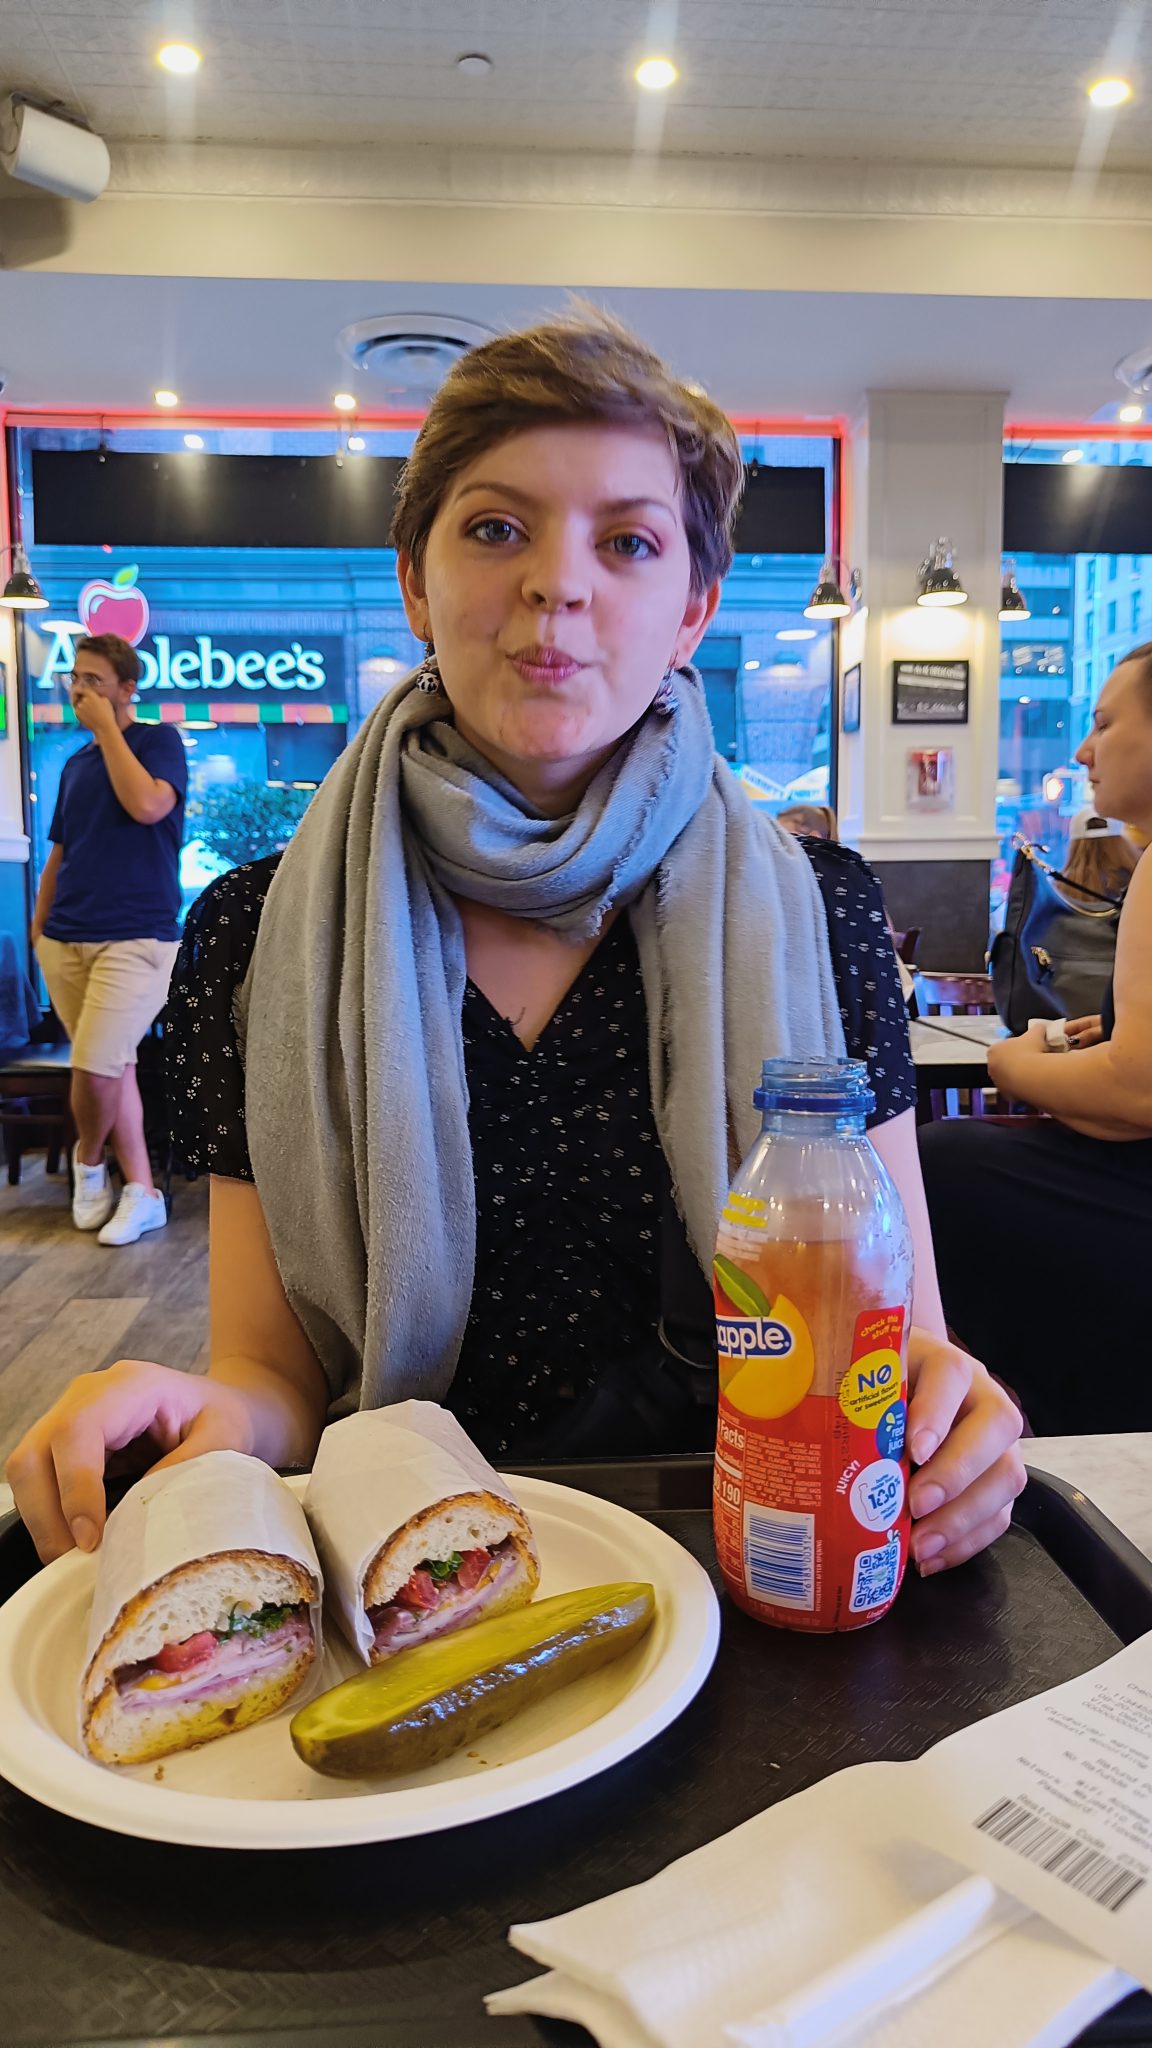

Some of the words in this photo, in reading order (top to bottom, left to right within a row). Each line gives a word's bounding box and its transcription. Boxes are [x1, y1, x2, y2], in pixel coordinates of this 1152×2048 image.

[37, 632, 327, 703] Aplebee's
[860, 1316, 885, 1338] check
[717, 1318, 785, 1360] apple
[850, 1389, 880, 1407] artificial
[854, 1404, 863, 1413] or
[720, 1418, 745, 1449] Facts
[722, 1481, 740, 1505] 190
[815, 1563, 823, 1579] AFTER
